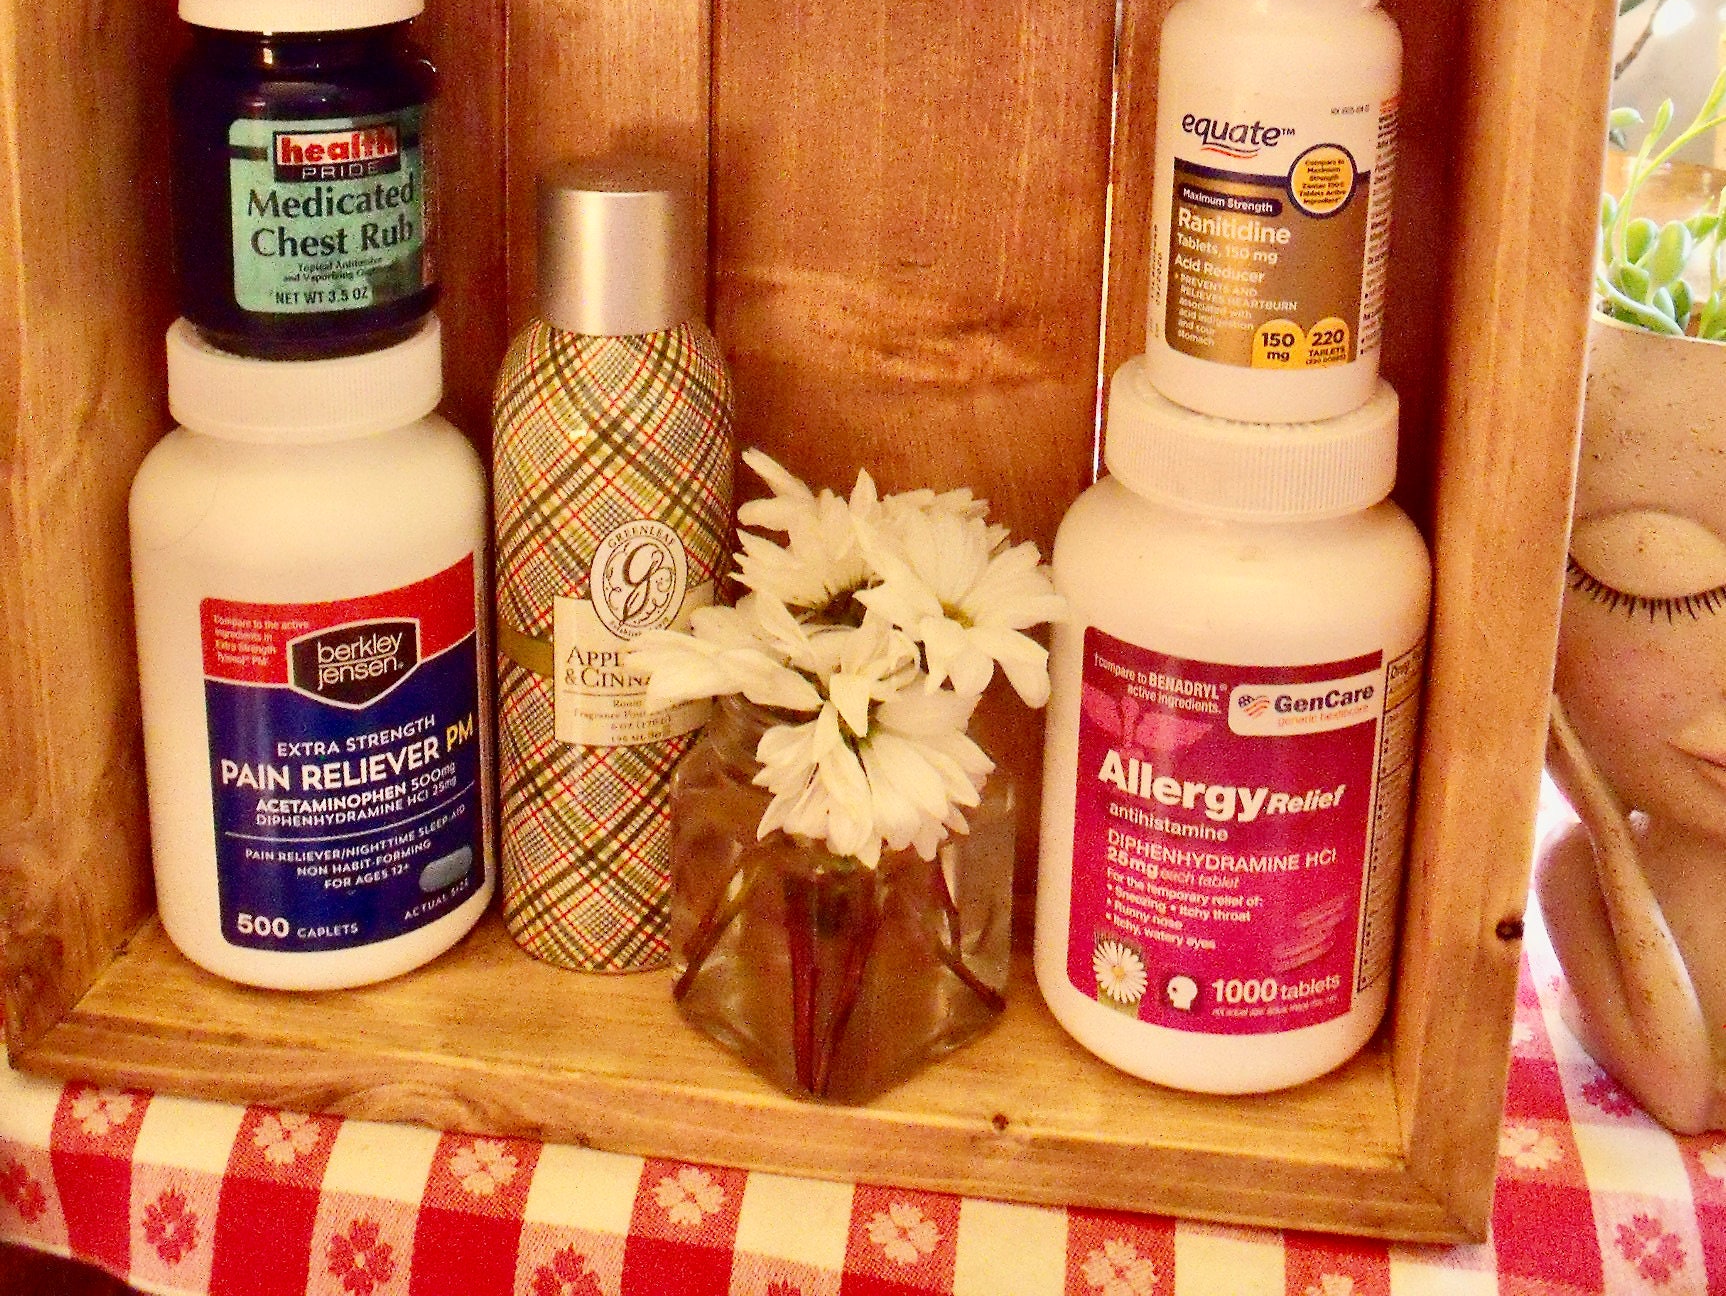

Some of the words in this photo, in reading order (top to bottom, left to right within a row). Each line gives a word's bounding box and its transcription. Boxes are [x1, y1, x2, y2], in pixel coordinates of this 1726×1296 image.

[281, 125, 397, 164] health
[1182, 113, 1281, 147] equate
[302, 163, 380, 180] PRIDE
[247, 172, 415, 219] Medicated
[1183, 187, 1226, 208] Maximum
[1227, 196, 1274, 214] Strength
[250, 226, 349, 257] Chest
[360, 214, 412, 253] Rub
[1177, 207, 1292, 246] Ranitidine
[1176, 232, 1221, 259] Tablets,
[1225, 245, 1250, 260] 150
[1253, 251, 1279, 265] mg
[1174, 253, 1202, 273] Acid
[1203, 261, 1266, 285] Reducer
[276, 291, 299, 305] NET
[303, 290, 324, 305] WT
[328, 287, 350, 304] 3.5
[352, 287, 369, 303] OZ
[1227, 294, 1298, 312] HEARTBURN
[1262, 332, 1297, 348] 150
[1309, 347, 1346, 358] TABLETS
[1311, 329, 1346, 347] 220
[1266, 350, 1290, 363] mg
[607, 524, 676, 549] GREENLEAF
[317, 632, 402, 664] berkley
[567, 645, 625, 668] APPL
[317, 655, 399, 692] jensen
[1137, 671, 1148, 685] to
[1127, 684, 1157, 702] active
[1274, 684, 1376, 713] GenCare
[277, 741, 340, 758] EXTRA
[346, 713, 436, 752] STRENGTH
[220, 758, 291, 792] PAIN
[301, 735, 440, 792] RELIEVER
[446, 711, 474, 753] PM
[255, 784, 407, 815] ACETAMINOPHEN
[411, 761, 456, 792] 500mg
[1098, 749, 1269, 822] Allergy
[1266, 784, 1348, 816] Relief
[255, 798, 403, 827] DIPHENHYDRAMINE
[1108, 802, 1229, 843] antihistamine
[245, 848, 275, 862] PAIN
[278, 829, 416, 864] RELIEVER/NIGHTTIME
[418, 814, 450, 839] SLEEP
[1107, 827, 1301, 874] DIPHENHYDRAMINE
[296, 864, 329, 878] NON
[332, 839, 432, 875] HABIT-FORMING
[324, 877, 352, 891] FOR
[355, 871, 389, 886] AGES
[1107, 866, 1124, 883] For
[1126, 875, 1145, 891] the
[1147, 882, 1210, 905] temporary
[1211, 895, 1245, 907] relief
[404, 892, 448, 921] ACTUAL
[1113, 899, 1151, 923] Runny
[1152, 916, 1184, 931] nose
[1179, 904, 1210, 921] Itchy
[1213, 909, 1252, 922] throat
[237, 911, 290, 939] 500
[296, 921, 359, 940] CAPLETS
[1144, 926, 1184, 947] watery
[1212, 977, 1278, 1004] 1000
[1280, 974, 1341, 1001] tablets
